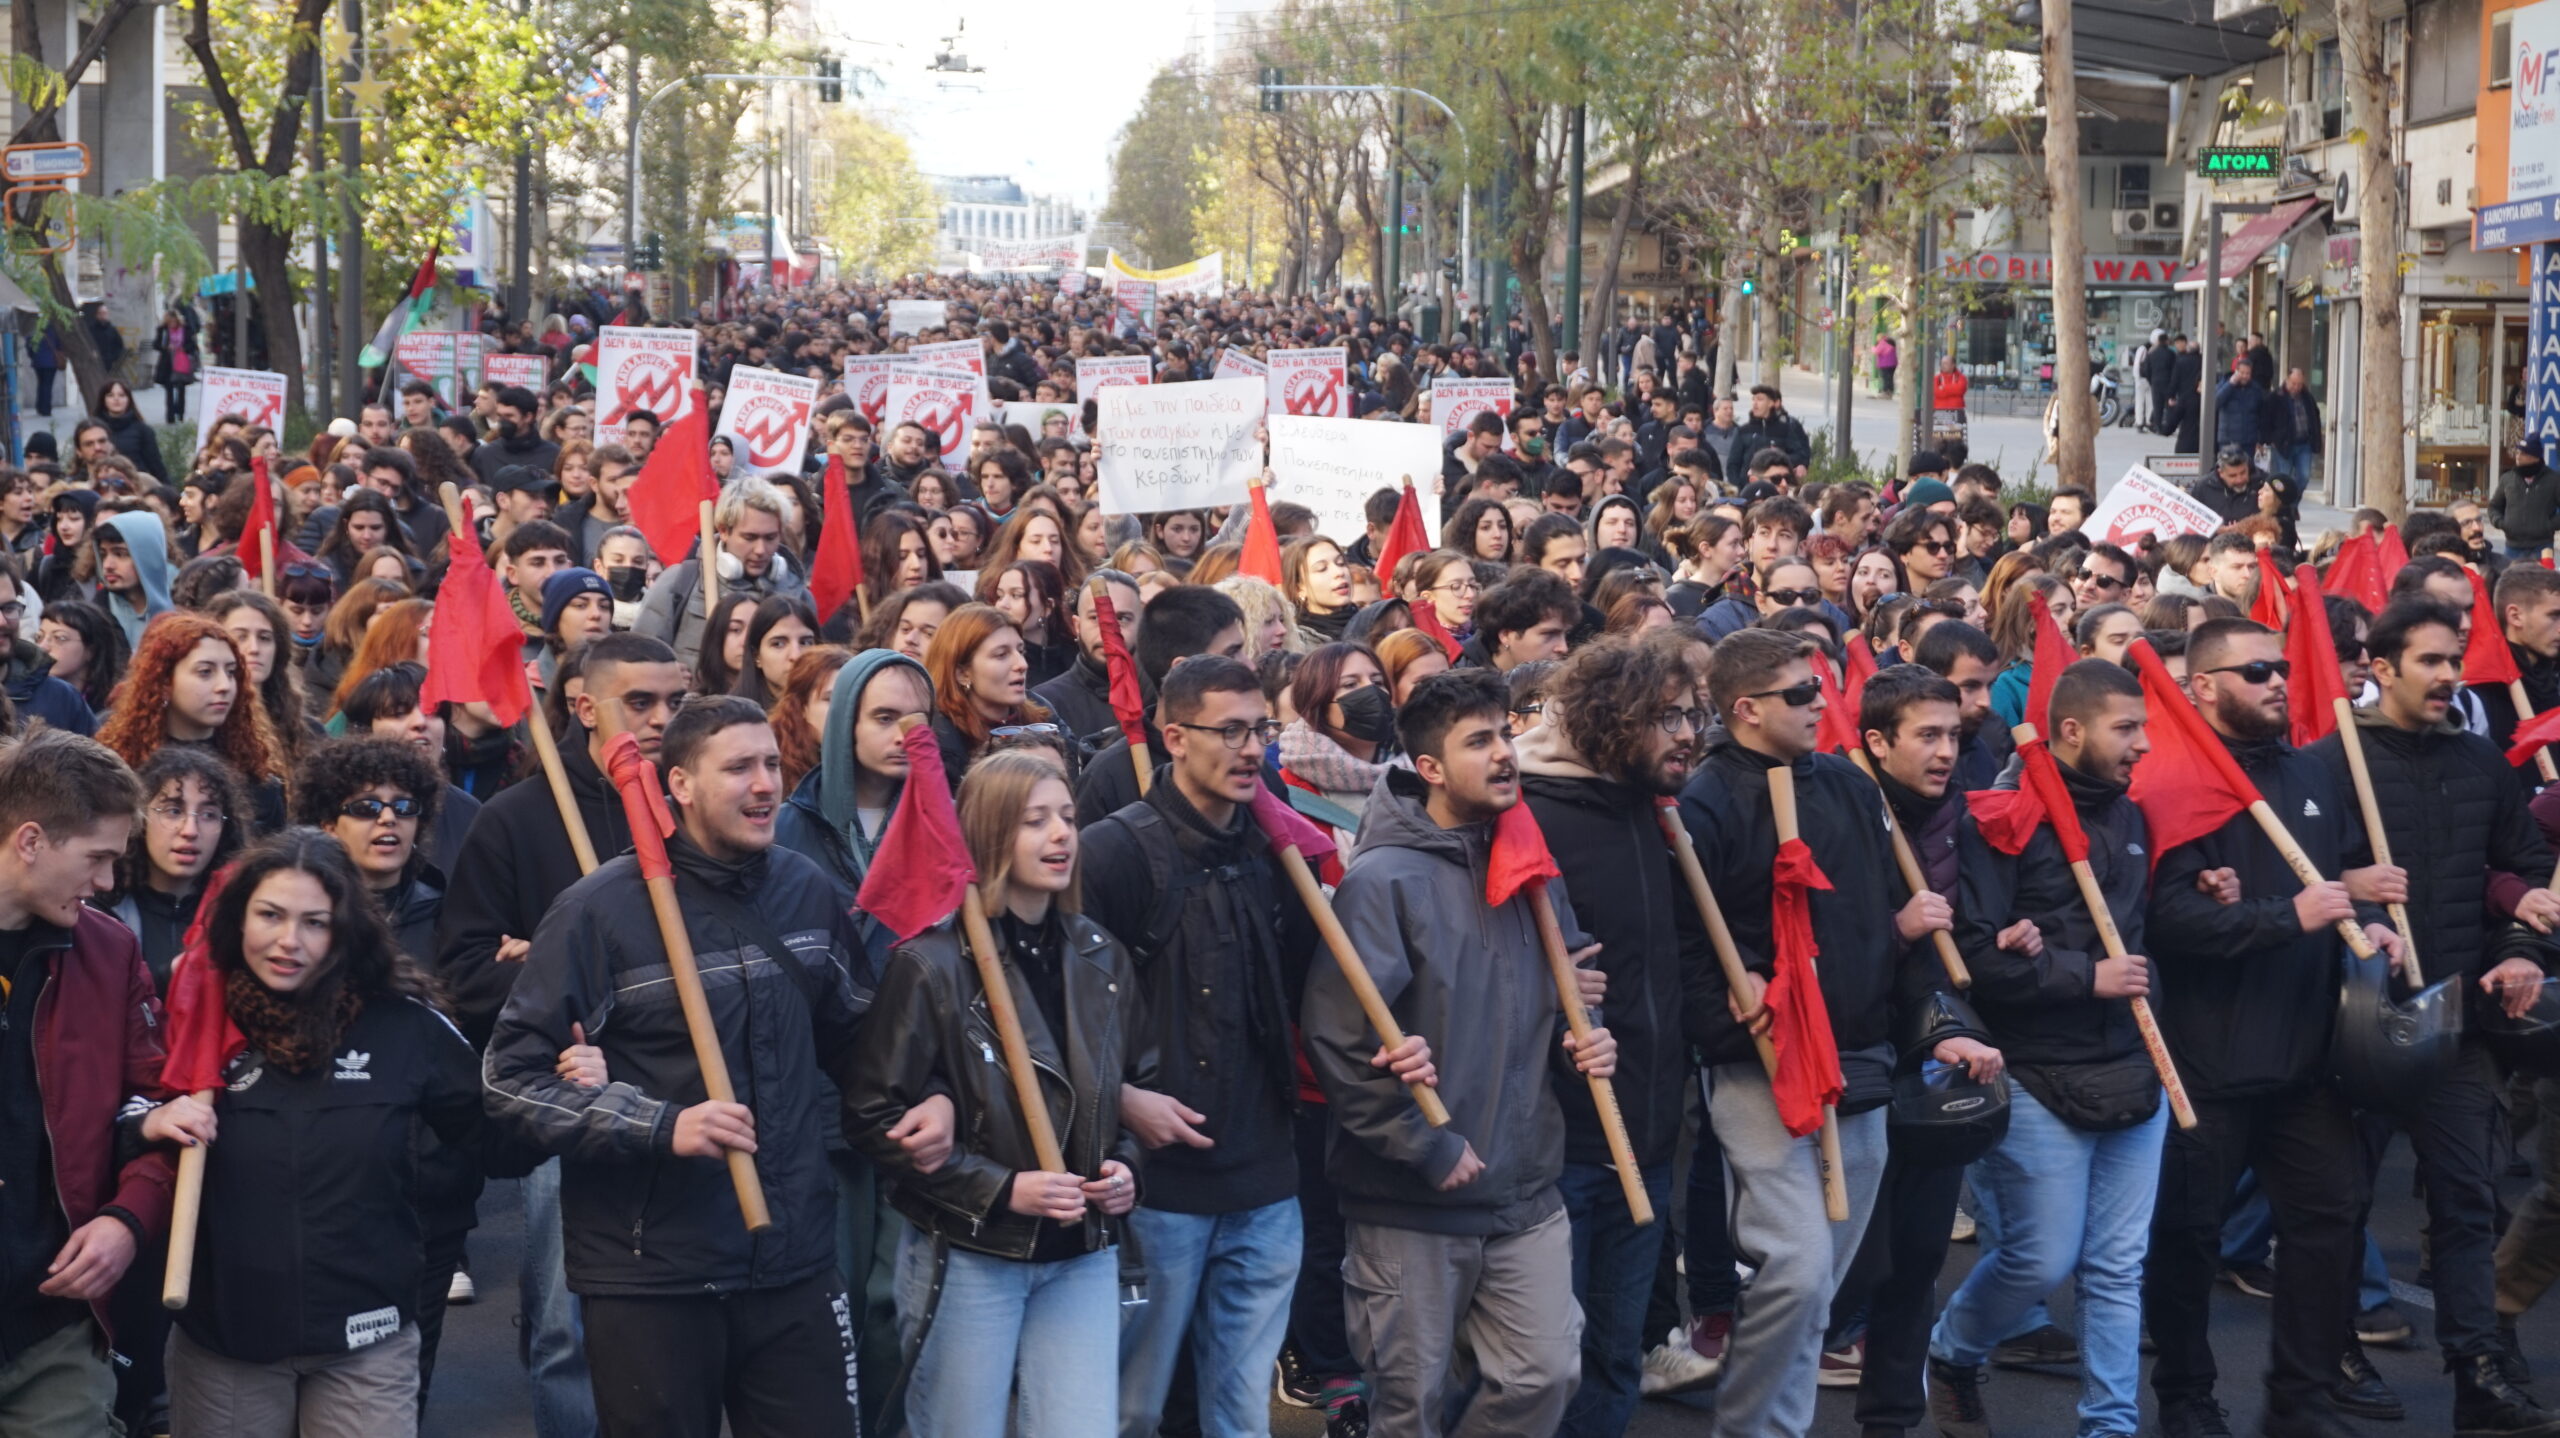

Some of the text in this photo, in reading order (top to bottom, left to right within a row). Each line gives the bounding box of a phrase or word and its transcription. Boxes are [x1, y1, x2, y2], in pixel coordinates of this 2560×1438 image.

[2520, 48, 2560, 96] MF
[2208, 154, 2269, 170] ΑΓΟΡΑ
[2483, 227, 2506, 247] SERVICE
[2093, 259, 2181, 281] WAY
[398, 334, 453, 345] ΛΕΥΤΕΡΙΑ
[604, 337, 692, 352] ΔΕΝ ΘΑ ΠΕΡΑΣΕΙ
[488, 357, 542, 369] ΛΕΥΤΕΡΙΑ
[1272, 359, 1289, 368] ΔΕΝ
[1293, 359, 1304, 367] ΘΑ
[1308, 356, 1343, 366] ΠΕΡΑΣΕΙ
[733, 378, 750, 390] ΔΕΝ
[753, 380, 765, 391] ΘΑ
[893, 375, 912, 385] ΔΕΝ
[916, 376, 929, 387] ΘΑ
[1436, 387, 1511, 398] ΔΕΝ ΘΑ ΠΕΡΑΣΕΙ
[2125, 478, 2213, 534] ΔΕΝ ΘΑ ΠΕΡΑΣΕΙ
[350, 1314, 397, 1335] ORIGINALS
